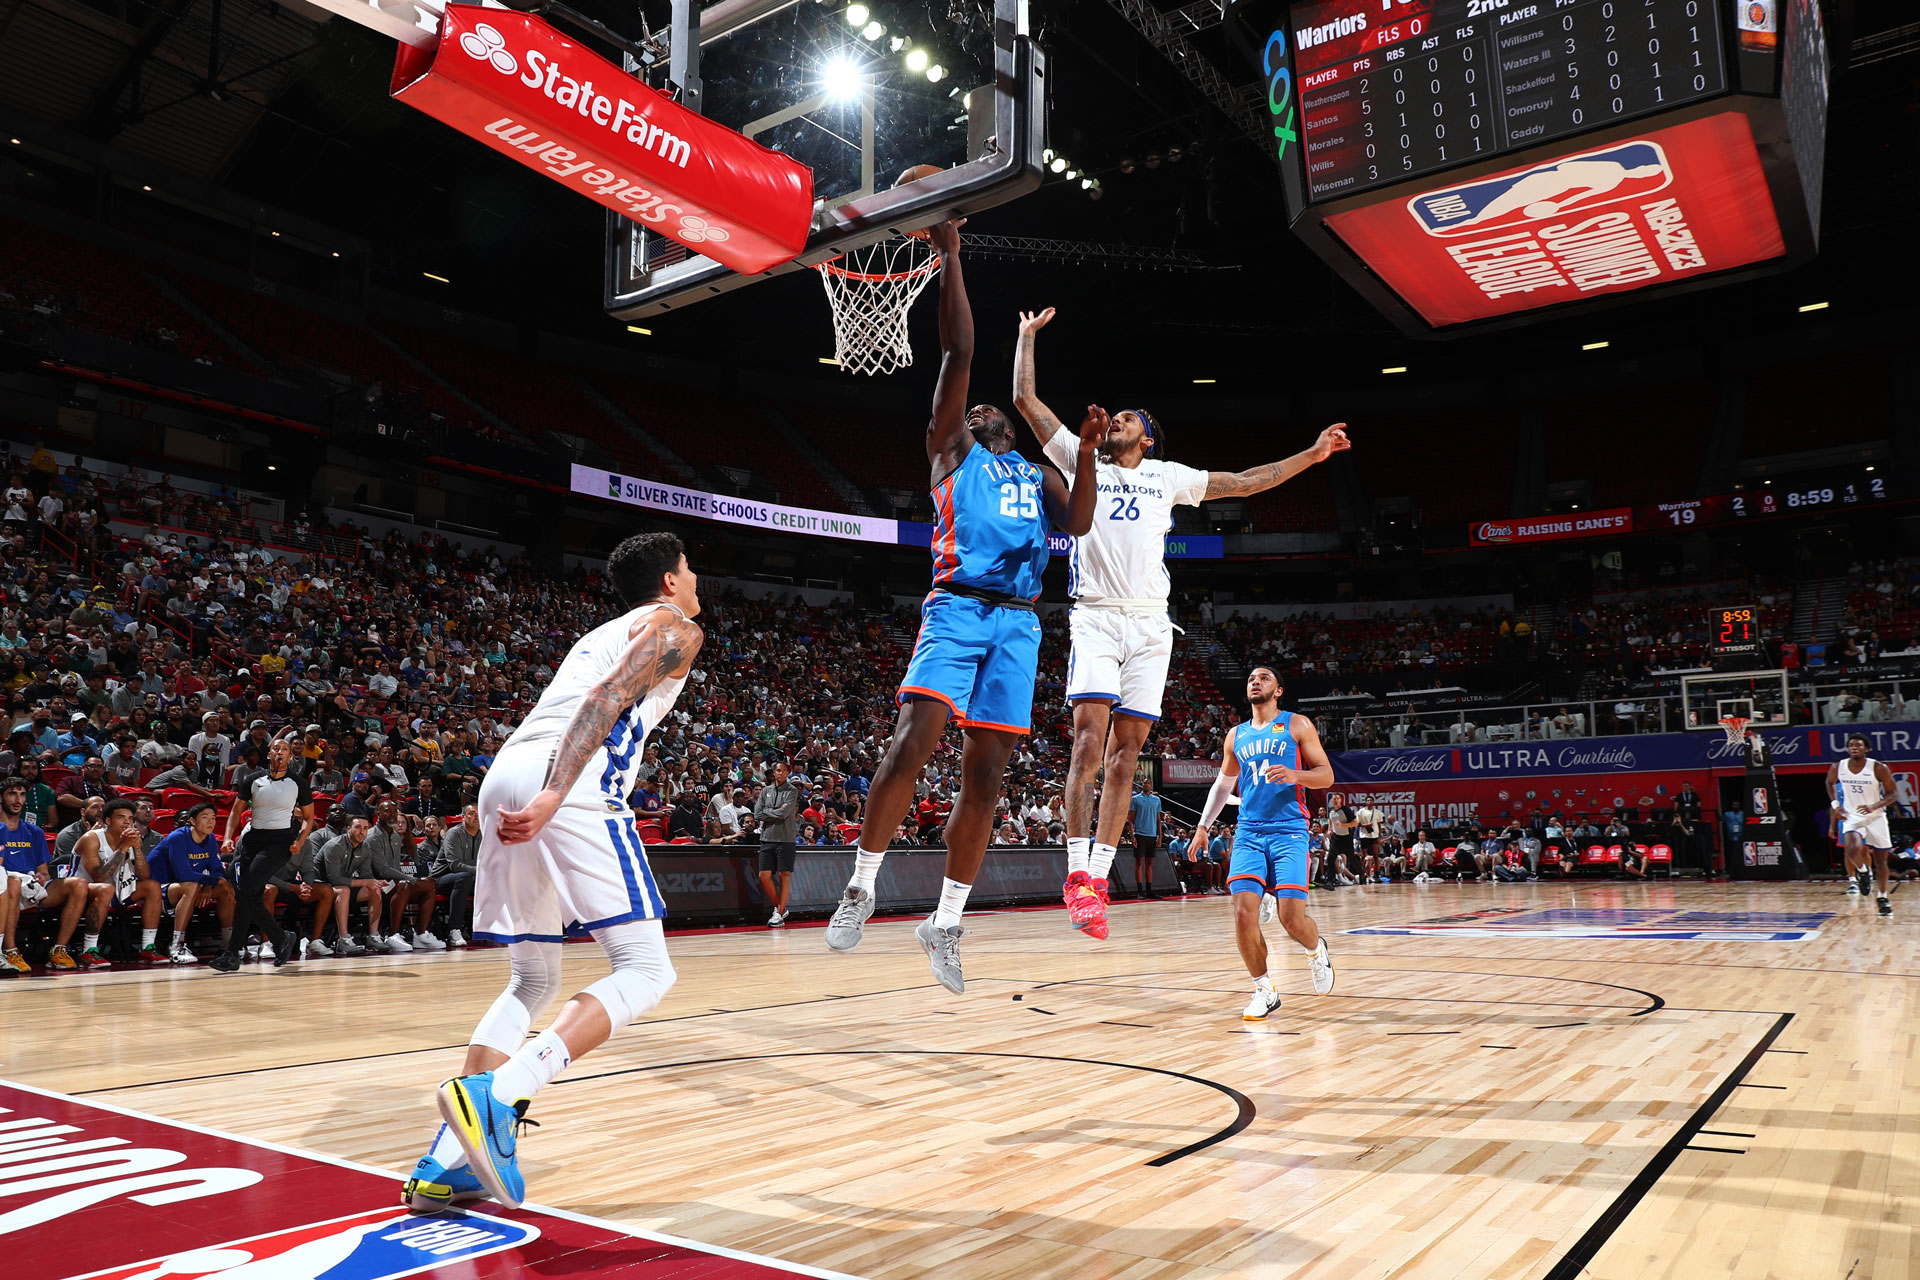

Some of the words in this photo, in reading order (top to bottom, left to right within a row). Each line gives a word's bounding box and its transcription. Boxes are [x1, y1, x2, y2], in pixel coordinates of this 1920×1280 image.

[1500, 5, 1538, 26] PLAYER
[1500, 29, 1544, 49] Williams
[1562, 15, 1573, 31] 0
[1602, 3, 1613, 18] 0
[1296, 12, 1367, 50] Warriors
[1377, 26, 1400, 44] FLS
[1410, 19, 1422, 36] 0
[1503, 54, 1539, 71] Waters
[1541, 49, 1551, 60] III
[1565, 38, 1576, 54] 3
[1605, 26, 1615, 42] 2
[1648, 13, 1657, 29] 1
[1686, 1, 1697, 17] 0
[1305, 69, 1338, 87] PLAYER
[1353, 59, 1371, 72] PTS
[1386, 48, 1406, 62] RBS
[1421, 36, 1440, 51] AST
[1456, 26, 1474, 40] FLS
[1505, 73, 1555, 95] Shackelford
[1567, 62, 1578, 79] 5
[1607, 50, 1618, 66] 0
[1648, 38, 1659, 54] 0
[1690, 27, 1700, 43] 1
[1304, 89, 1350, 110] Weatherspoon
[1359, 79, 1369, 94] 2
[1393, 69, 1403, 83] 0
[1428, 58, 1438, 73] 0
[1463, 47, 1473, 62] 0
[1508, 98, 1553, 117] Omoruyi
[1570, 85, 1580, 100] 4
[1609, 74, 1620, 90] 0
[1652, 62, 1662, 79] 1
[1692, 50, 1702, 67] 1
[1306, 114, 1339, 130] Santos
[1362, 100, 1372, 115] 5
[1395, 90, 1405, 105] 0
[1430, 79, 1440, 94] 0
[1465, 69, 1475, 84] 0
[1511, 124, 1545, 140] Gaddy
[1572, 108, 1583, 124] 0
[1612, 97, 1623, 113] 0
[1655, 86, 1664, 102] 1
[1694, 74, 1705, 91] 0
[1309, 136, 1345, 152] Morales
[1364, 122, 1374, 138] 3
[1399, 113, 1408, 128] 1
[1433, 102, 1443, 117] 0
[1469, 92, 1478, 107] 1
[1310, 160, 1335, 173] Willis
[1366, 144, 1376, 158] 0
[1400, 134, 1410, 149] 0
[1435, 124, 1445, 139] 0
[1470, 114, 1480, 129] 0
[1312, 176, 1354, 193] Wiseman
[1368, 165, 1378, 180] 3
[1403, 155, 1412, 171] 5
[1438, 146, 1447, 161] 1
[1473, 136, 1482, 152] 1
[1423, 194, 1472, 222] NBA
[1537, 212, 1661, 292] SUMMER
[1445, 231, 1569, 300] LEAGUE
[253, 277, 277, 297] 228
[117, 399, 148, 421] 117
[419, 470, 441, 488] 118
[1846, 484, 1855, 495] 1
[1871, 479, 1884, 492] 2
[625, 482, 669, 505] SILVER
[671, 492, 707, 512] STATE
[711, 501, 767, 522] SCHOOLS
[772, 511, 818, 532] CREDIT
[821, 519, 862, 536] UNION
[1000, 483, 1038, 518] 25
[1109, 497, 1140, 521] 26
[1658, 500, 1701, 512] Warriors
[1733, 497, 1744, 510] 2
[1764, 495, 1773, 505] 0
[1787, 488, 1834, 507] 8:59
[1517, 521, 1572, 537] RAISING
[1669, 509, 1696, 526] 19
[697, 579, 721, 594] 119
[1351, 605, 1372, 618] 121
[1723, 609, 1751, 623] 8:59
[1720, 623, 1749, 643] 21
[1236, 738, 1287, 763] THUNDER
[1368, 753, 1447, 776] Michelob
[1468, 748, 1550, 770] ULTRA
[1558, 746, 1636, 769] Courtside
[1248, 758, 1272, 786] 14
[1850, 784, 1864, 794] 33
[381, 1220, 506, 1255] NBA
